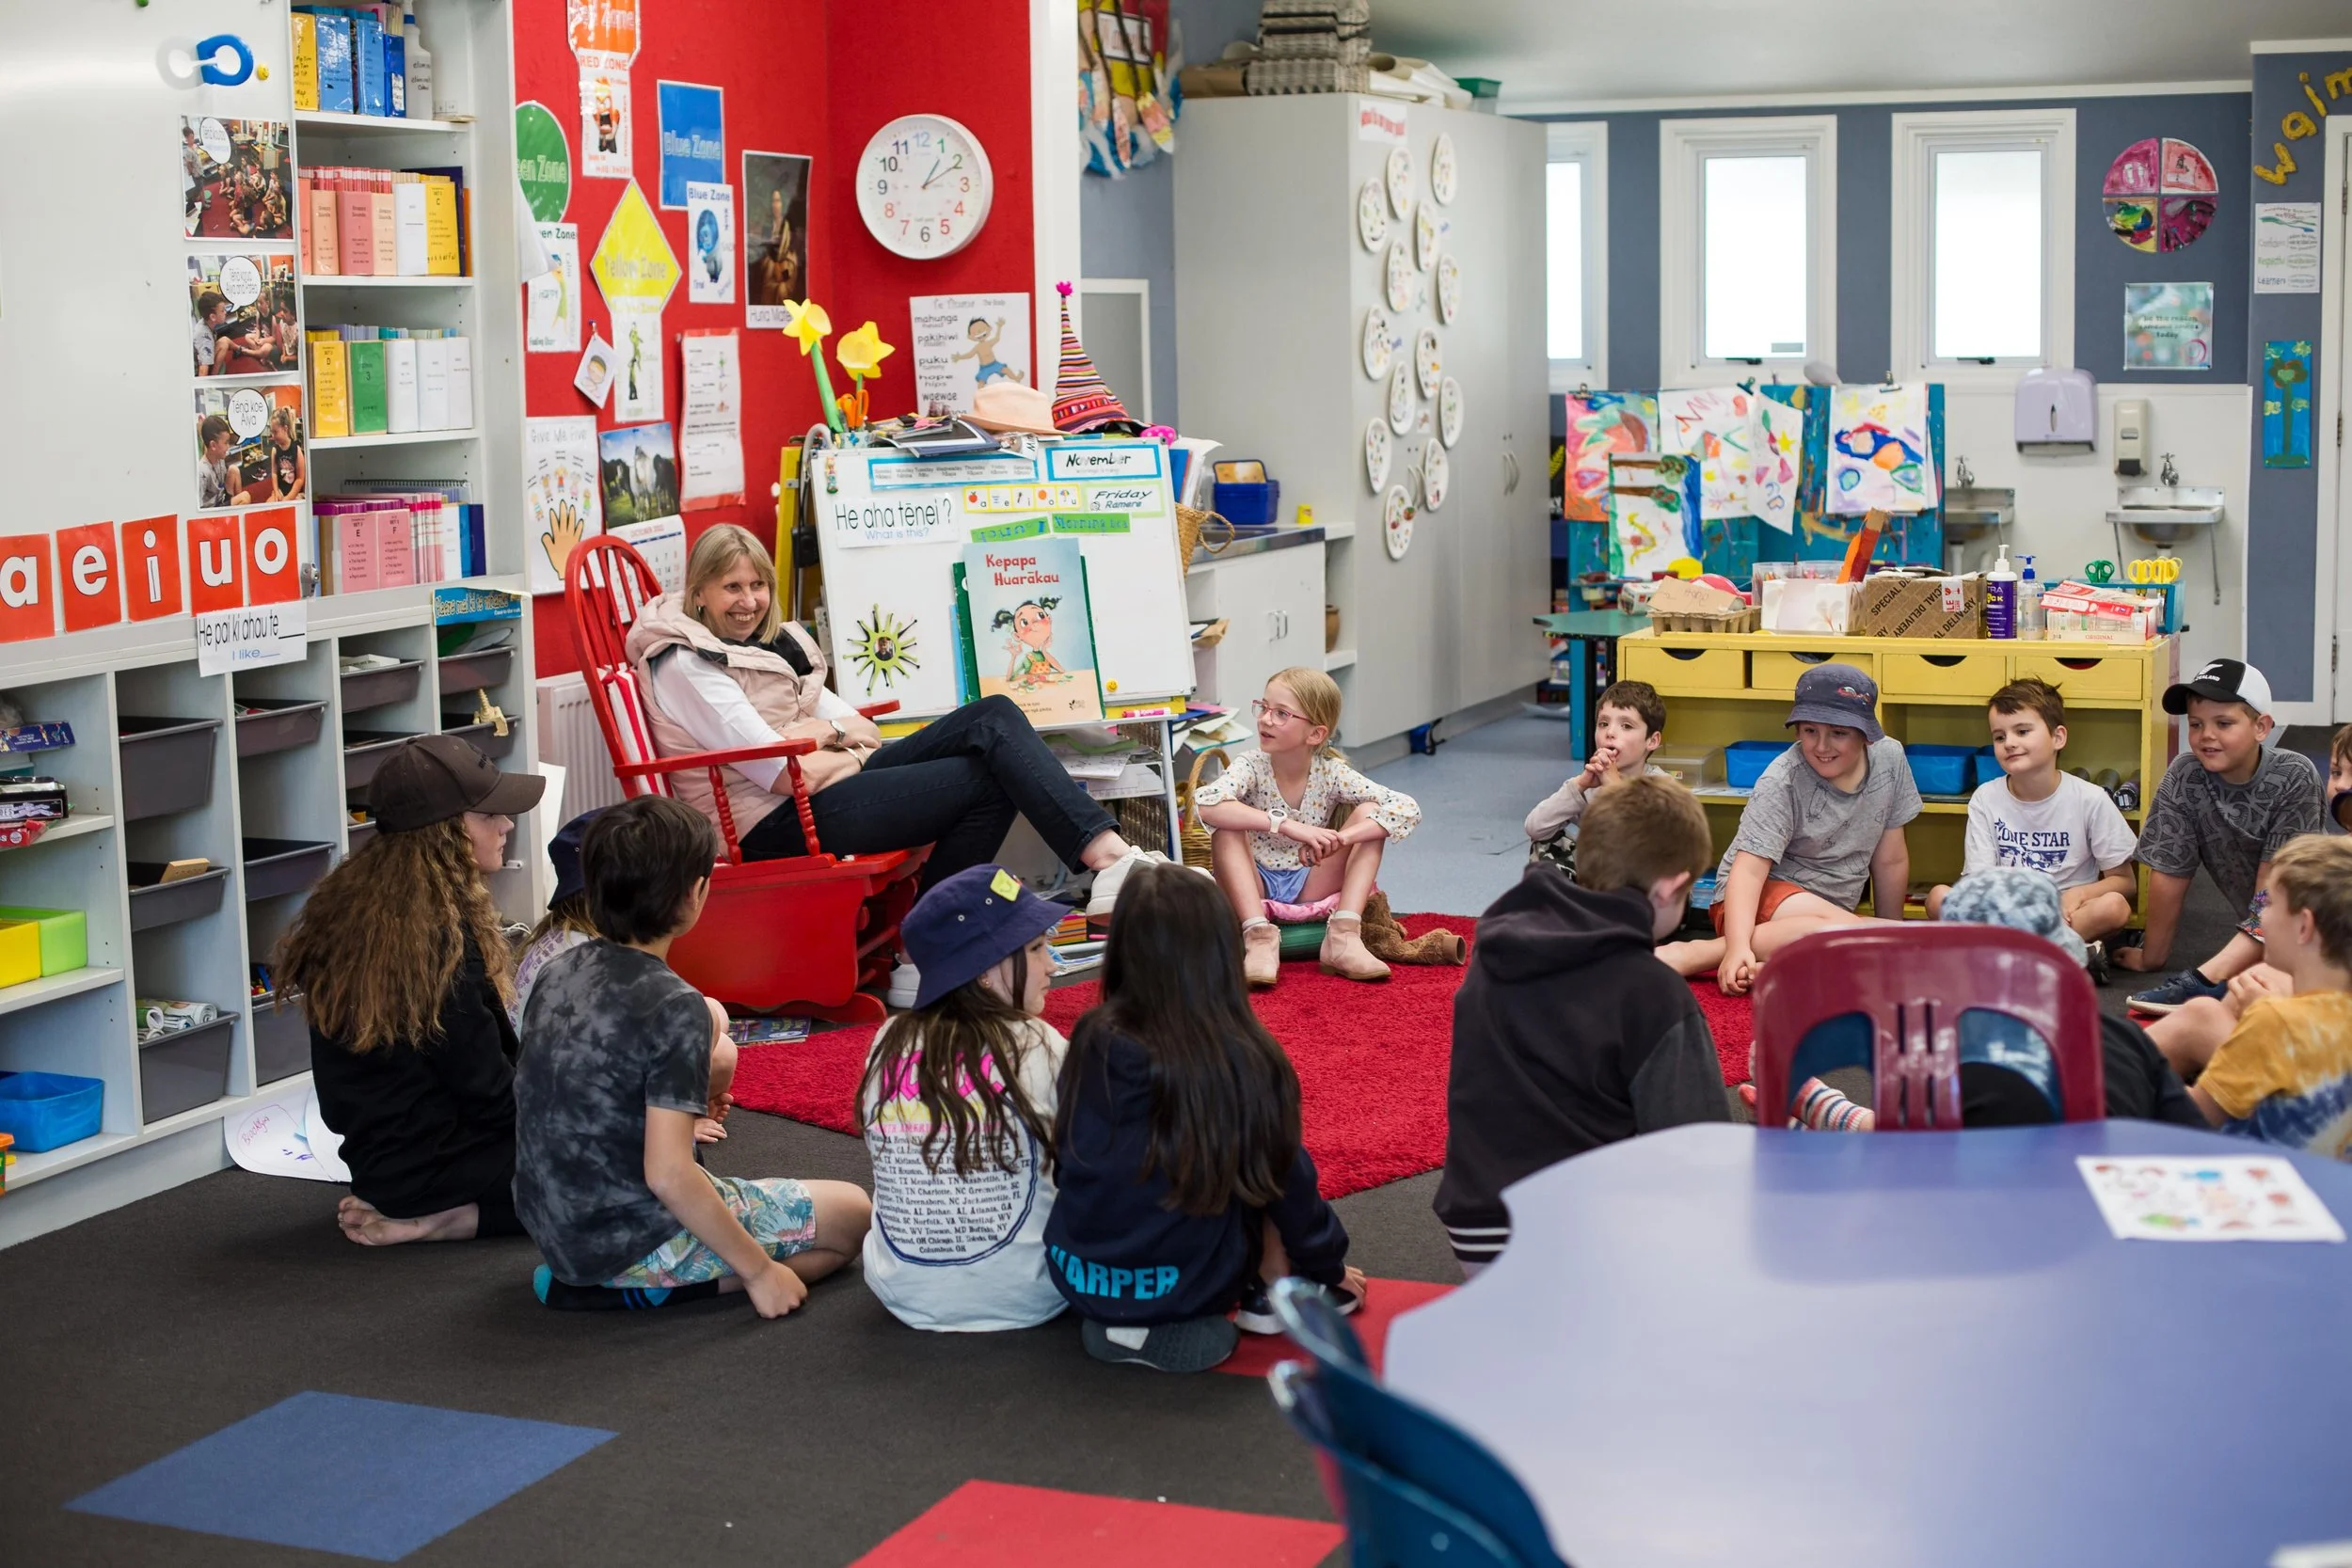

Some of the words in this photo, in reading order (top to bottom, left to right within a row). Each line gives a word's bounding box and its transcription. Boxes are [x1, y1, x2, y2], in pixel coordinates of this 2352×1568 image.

[580, 55, 599, 68] RED
[664, 131, 690, 157] Blue
[691, 134, 721, 160] Zone
[892, 139, 909, 155] 11
[913, 132, 930, 148] 12
[937, 137, 945, 153] 1
[517, 161, 536, 181] een
[537, 155, 566, 183] Zone
[880, 156, 898, 172] 10
[952, 154, 962, 169] 2
[877, 180, 887, 195] 9
[960, 177, 970, 193] 3
[689, 188, 707, 199] Blue
[710, 189, 730, 201] Zone
[884, 202, 895, 218] 8
[954, 200, 964, 216] 4
[556, 229, 576, 239] Zone
[900, 220, 910, 236] 7
[940, 218, 950, 234] 5
[920, 226, 930, 243] 6
[605, 253, 637, 277] Yellow
[641, 256, 667, 278] Zone
[914, 314, 958, 324] mahunga
[918, 334, 958, 344] pakihiwi
[919, 356, 948, 367] puku
[922, 392, 957, 402] waewae
[532, 428, 549, 443] Give
[1095, 489, 1152, 499] Friday
[835, 503, 859, 531] He
[864, 502, 895, 529] aha
[898, 499, 940, 527] tēnei
[1055, 515, 1105, 532] Morning
[866, 531, 893, 540] What
[896, 530, 903, 539] is
[905, 528, 930, 538] this?
[1, 555, 38, 609] a
[72, 545, 107, 596] e
[143, 530, 161, 603] i
[199, 537, 232, 587] u
[253, 527, 289, 575] o
[985, 553, 1037, 572] Kepapa
[993, 570, 1059, 586] Huarākau
[1870, 587, 1901, 617] SPECIAL
[1923, 583, 1943, 606] CIAL
[1893, 604, 1927, 638] DELIVERY
[1943, 597, 1977, 632] DELIVERY
[199, 618, 213, 647] He
[215, 614, 230, 652] pai
[232, 613, 241, 641] ki
[243, 611, 267, 641] ahau
[232, 651, 235, 660] I
[239, 649, 261, 660] like
[2032, 832, 2070, 847] STAR
[242, 1116, 271, 1146] Brooklyn
[911, 1178, 945, 1186] Memphis,
[963, 1176, 999, 1184] Nashville,
[918, 1187, 952, 1196] Charlotte,
[969, 1185, 1009, 1195] Greenville,
[949, 1196, 960, 1205] NC
[962, 1195, 1010, 1205] Jacksonville,
[1001, 1202, 1012, 1212] GA
[997, 1212, 1011, 1222] WV
[997, 1223, 1007, 1232] NY
[919, 1245, 954, 1254] Columbus,
